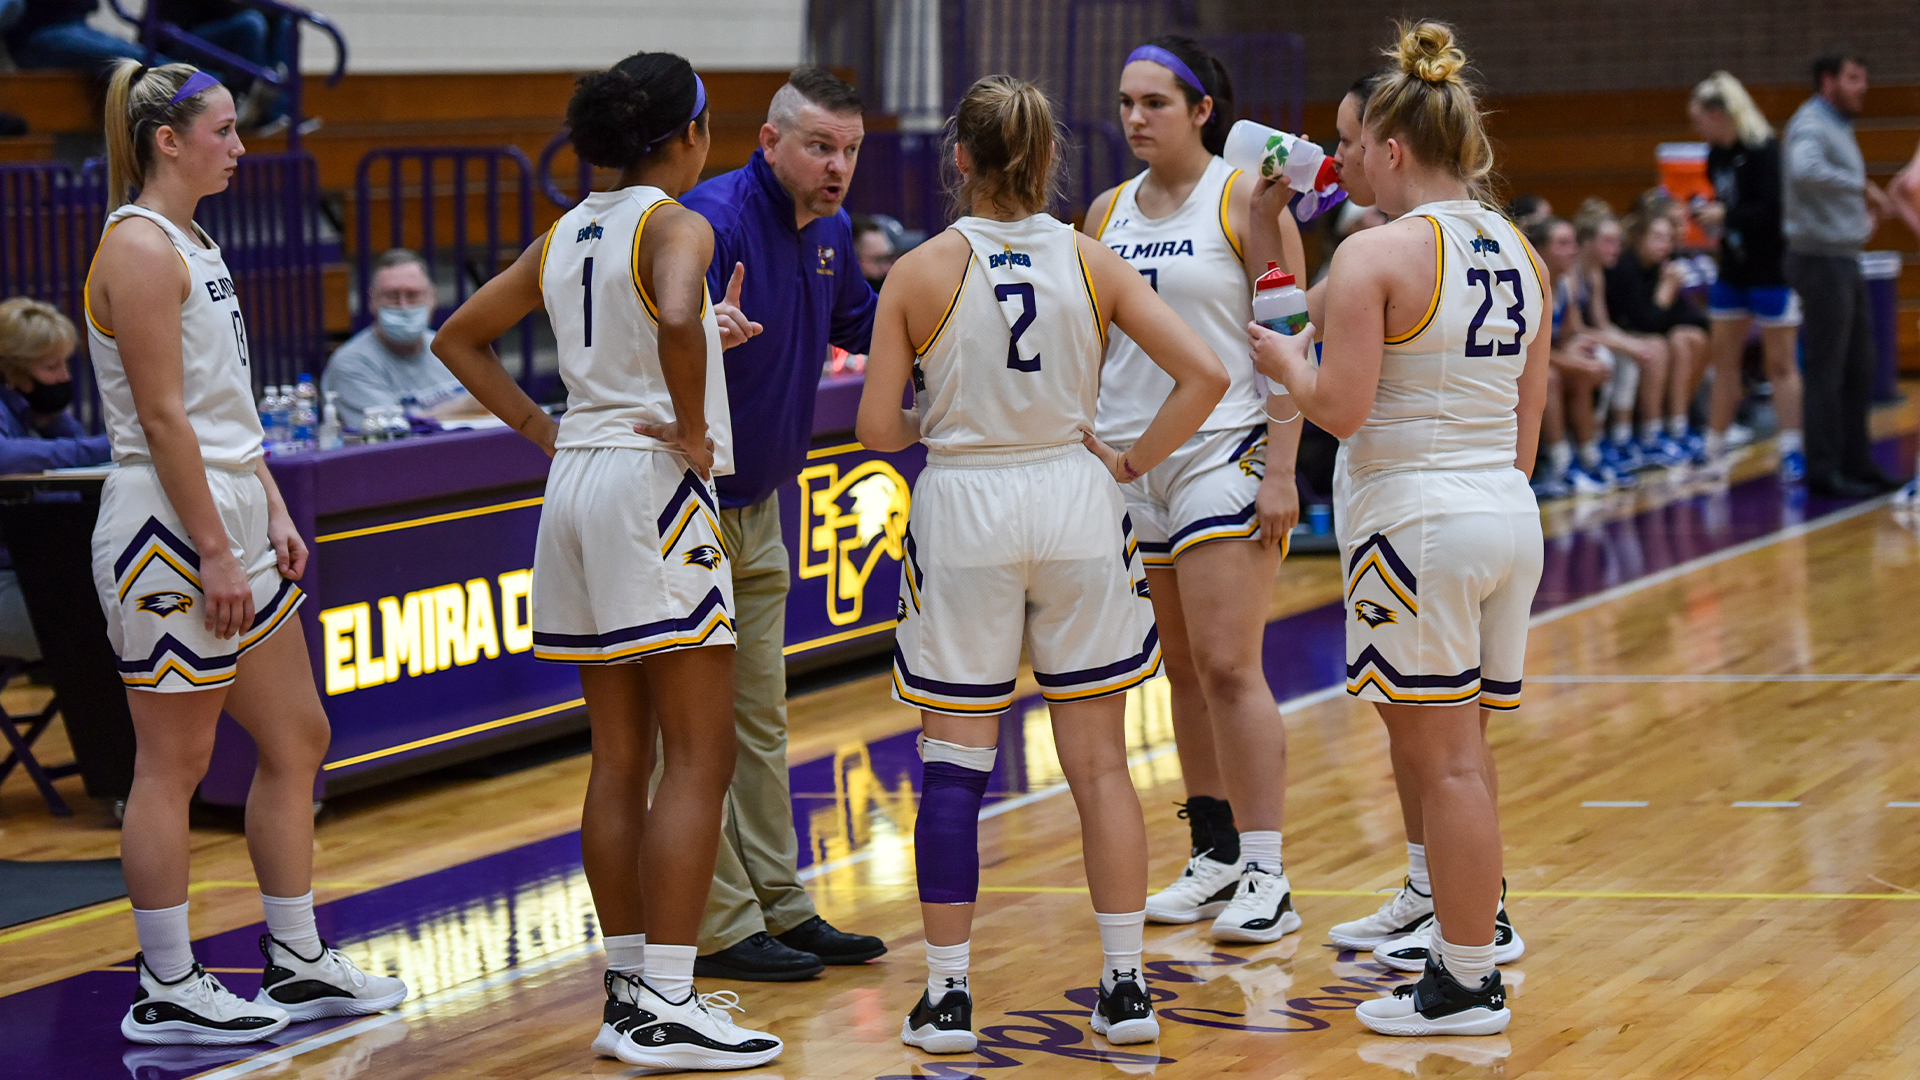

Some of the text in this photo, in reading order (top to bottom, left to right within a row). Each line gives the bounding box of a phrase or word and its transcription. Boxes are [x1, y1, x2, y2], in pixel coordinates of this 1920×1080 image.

[581, 256, 594, 348] 1
[994, 282, 1042, 373] 2
[1464, 267, 1527, 358] 23
[318, 576, 501, 697] ELMIRA
